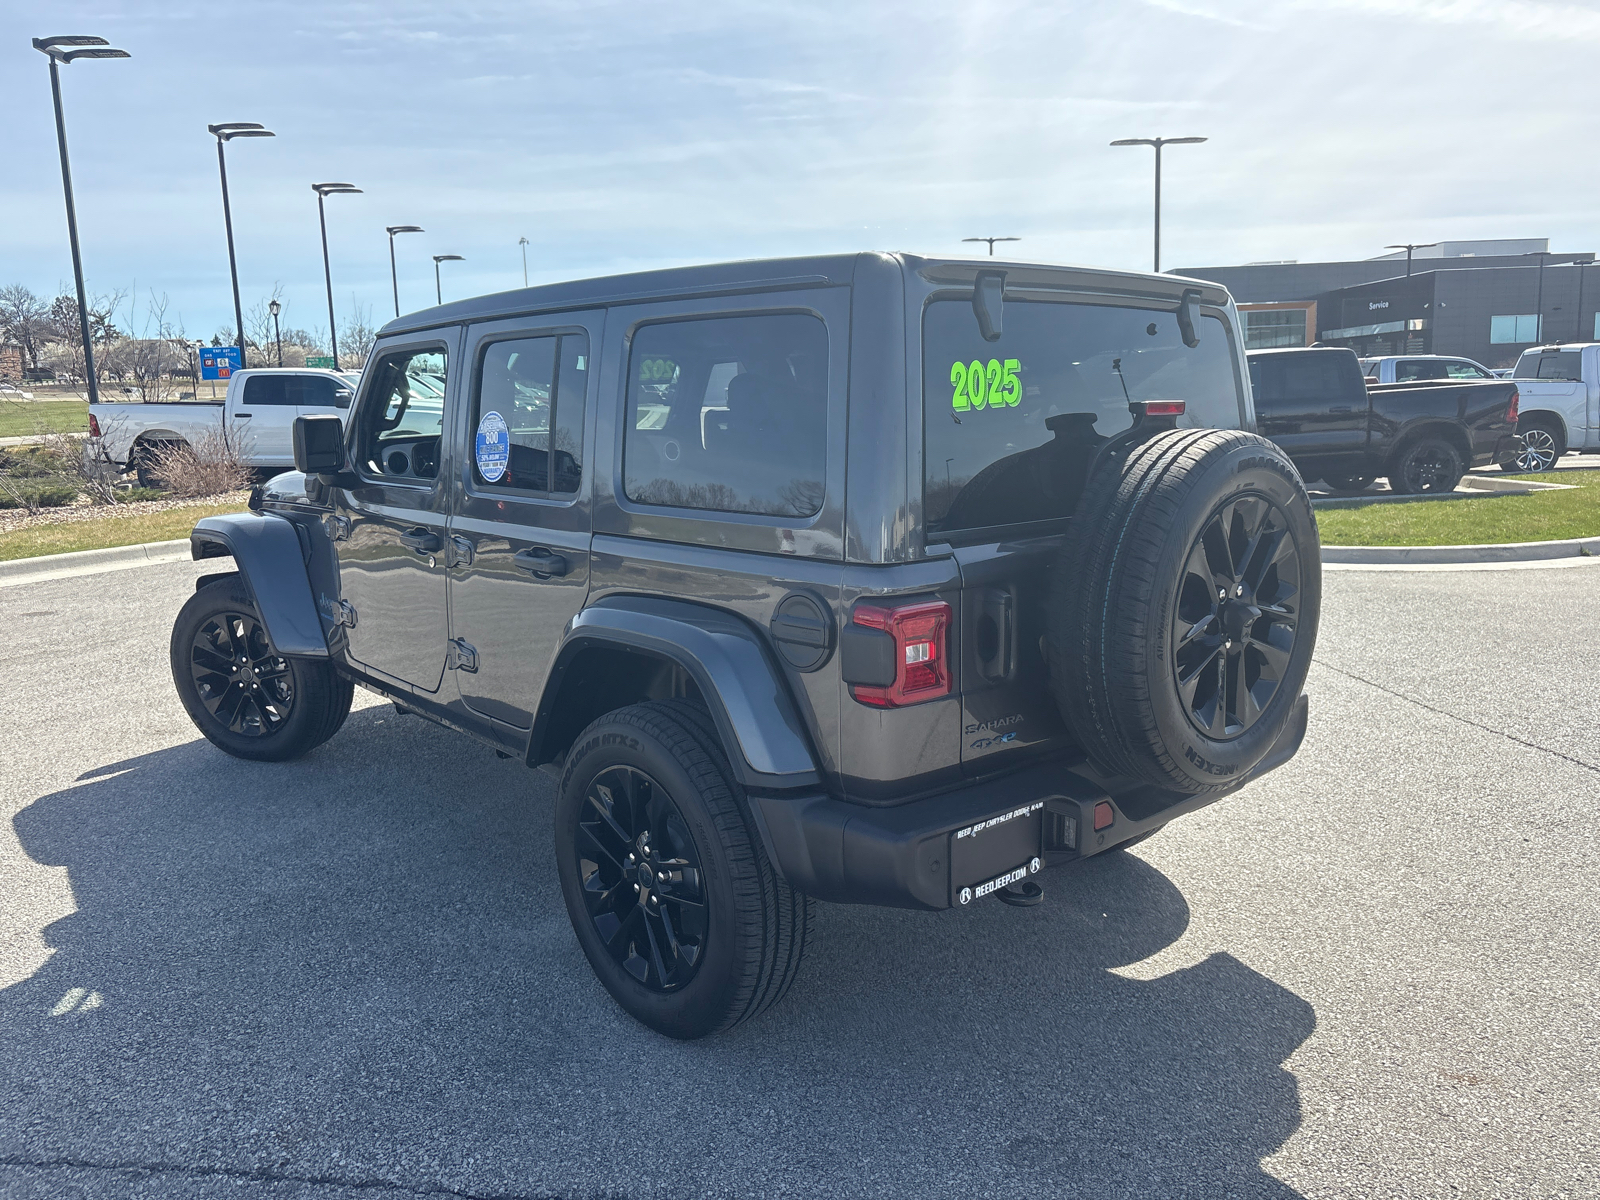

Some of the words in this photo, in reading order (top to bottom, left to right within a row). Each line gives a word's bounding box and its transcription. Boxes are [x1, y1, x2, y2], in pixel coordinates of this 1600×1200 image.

[1369, 300, 1389, 310] Service
[950, 358, 1022, 412] 2025
[485, 430, 499, 445] 800
[965, 713, 1025, 735] SAHARA
[1185, 745, 1235, 776] NEXEN
[957, 827, 972, 839] REED
[973, 821, 986, 832] JEEP
[985, 811, 1013, 828] CHRYSLER
[1013, 806, 1030, 818] DODGE
[1030, 801, 1044, 811] RAM
[975, 866, 1027, 898] REEDJEEP.COM
